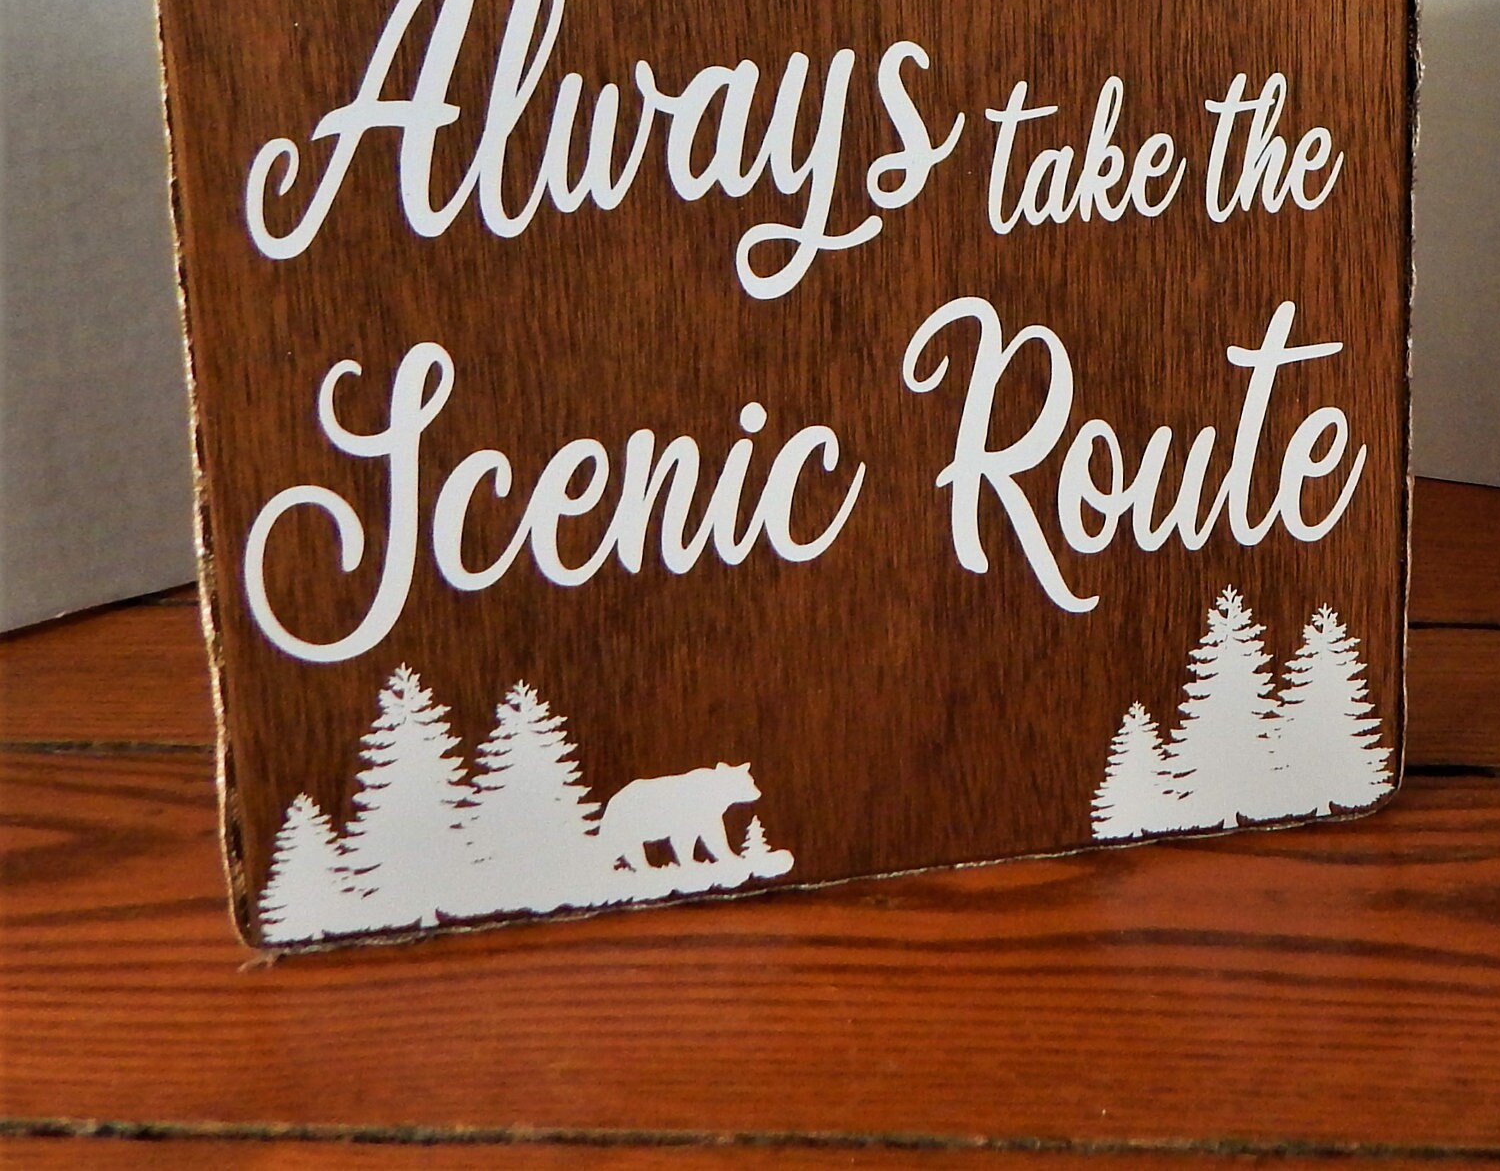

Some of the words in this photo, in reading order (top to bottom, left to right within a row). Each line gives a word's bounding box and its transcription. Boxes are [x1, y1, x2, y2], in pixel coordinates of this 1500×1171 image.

[984, 75, 1187, 235] take
[1204, 72, 1344, 223] the
[244, 342, 866, 663] Scenic
[902, 296, 1367, 613] Route
